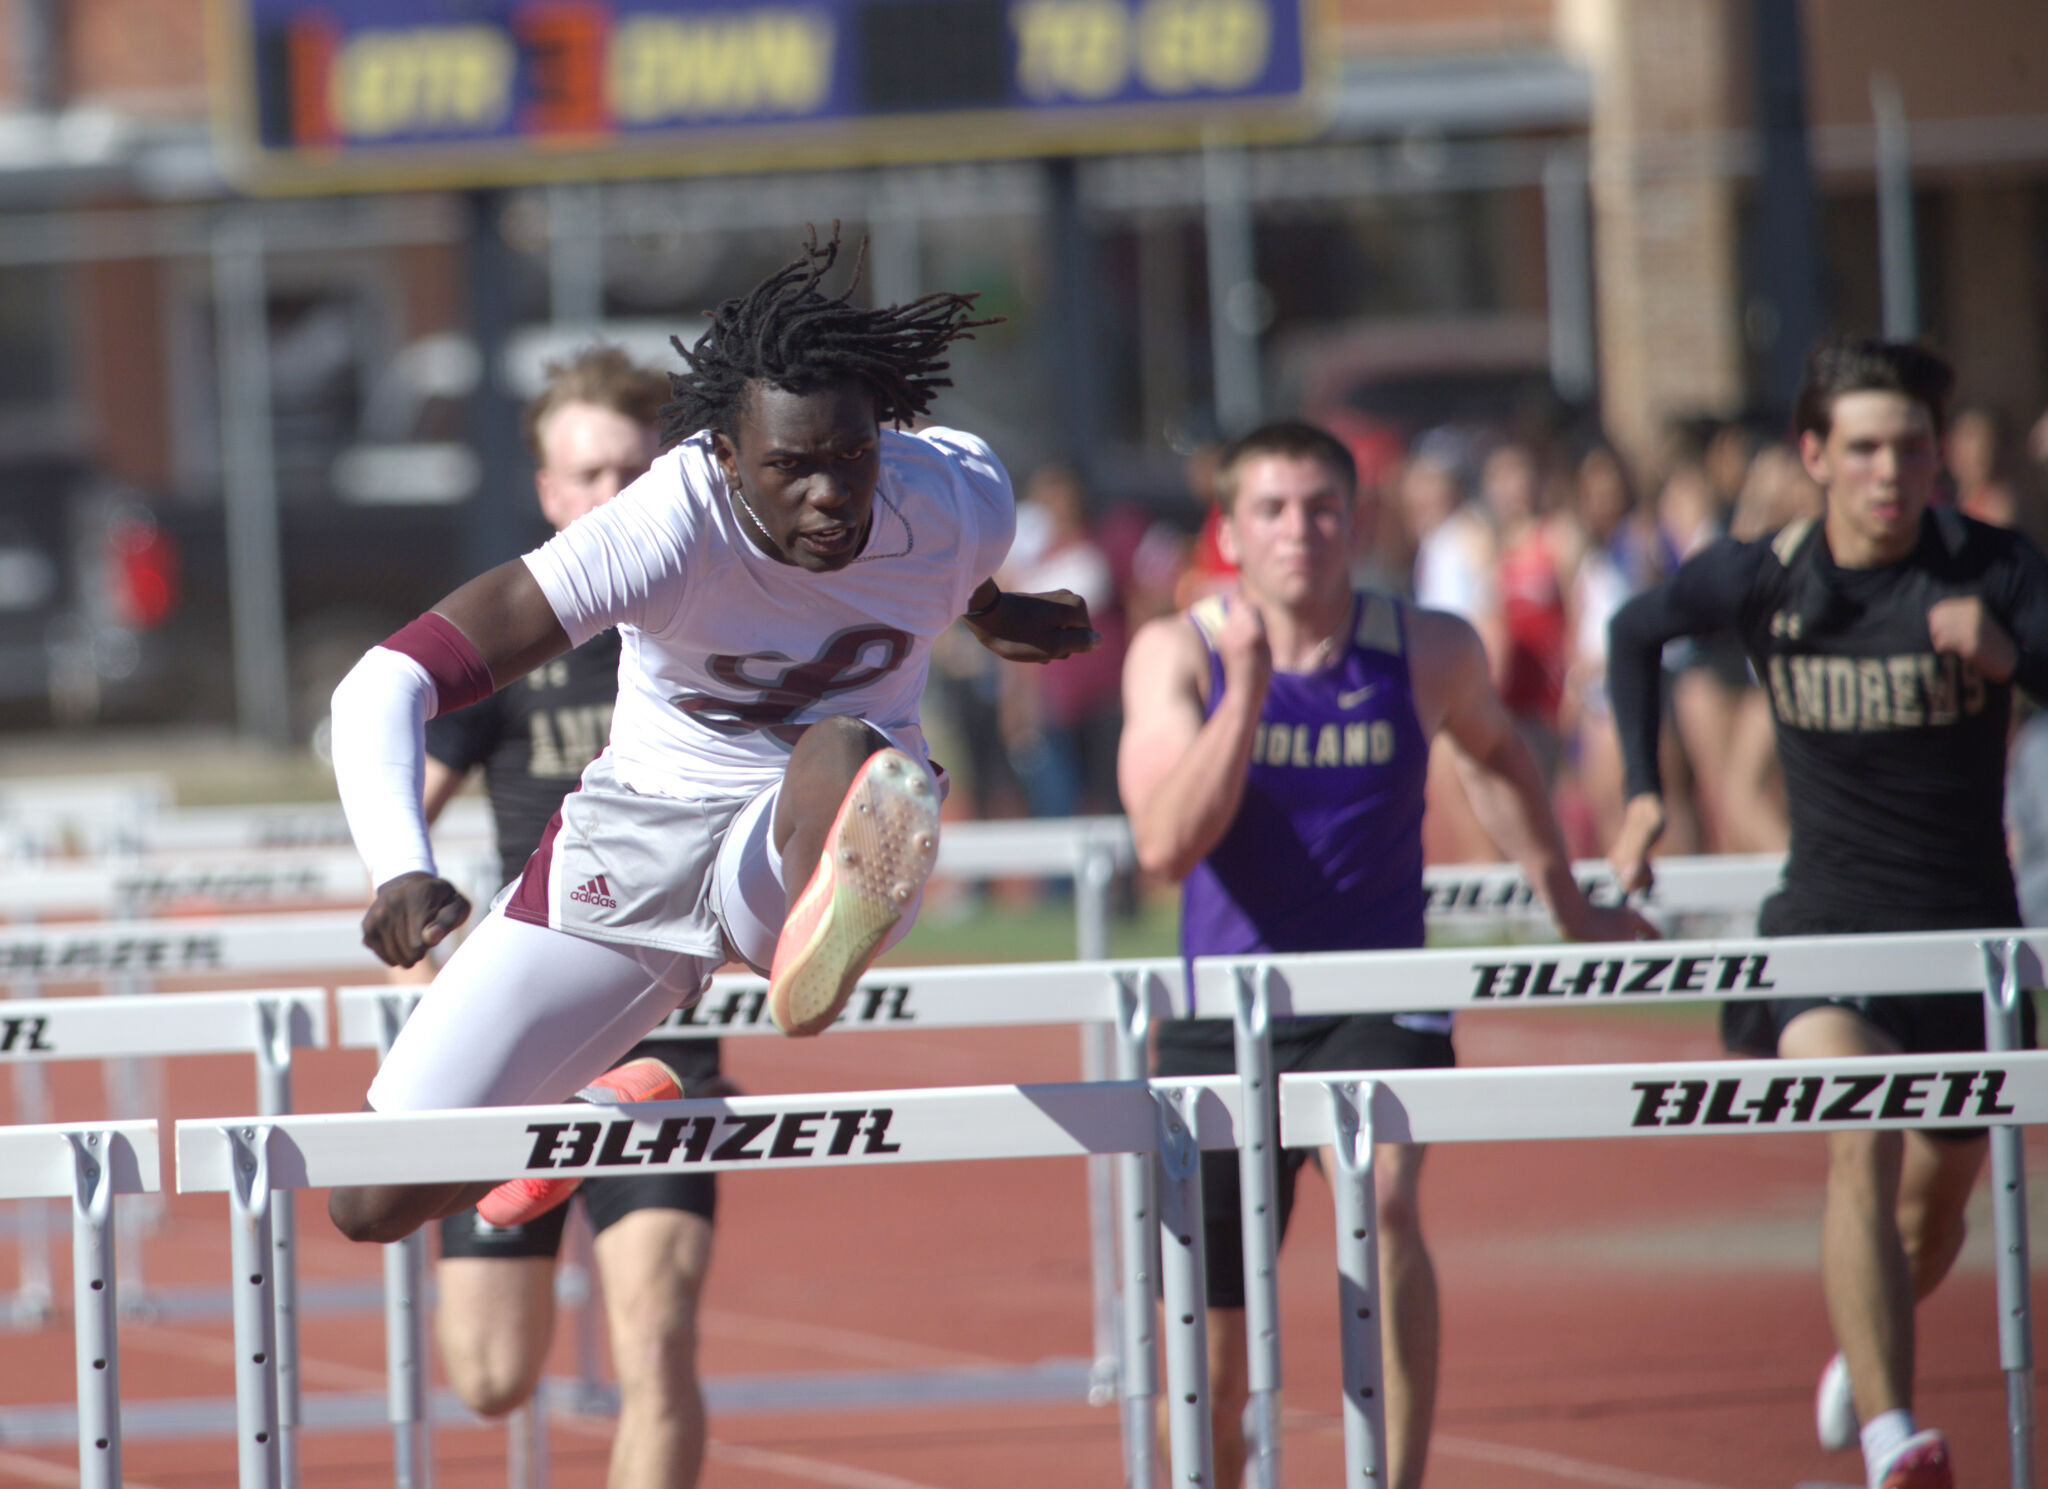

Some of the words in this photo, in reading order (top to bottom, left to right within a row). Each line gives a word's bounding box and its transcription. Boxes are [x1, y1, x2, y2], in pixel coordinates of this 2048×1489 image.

[1252, 718, 1396, 769] IDLAND
[569, 888, 618, 910] adidas
[1470, 953, 1776, 1000] BLAZER
[1630, 1068, 2016, 1128] BLAZER
[525, 1108, 902, 1170] BLAZER
